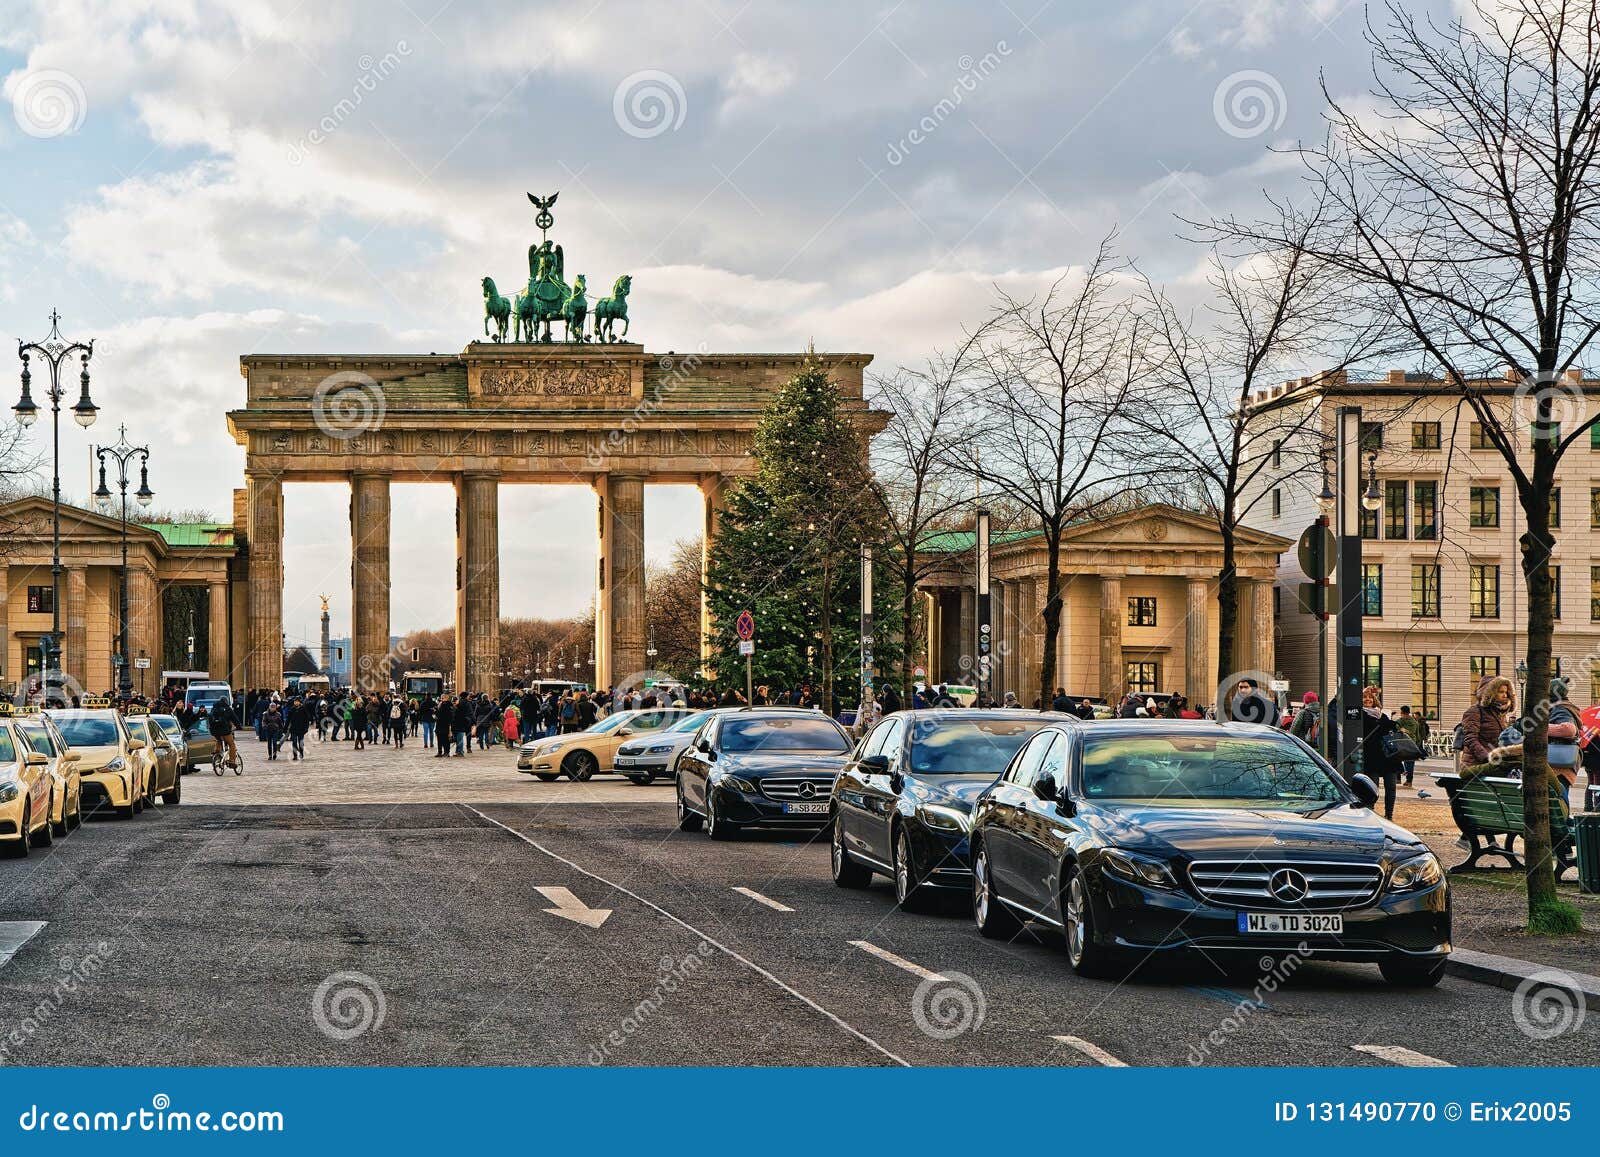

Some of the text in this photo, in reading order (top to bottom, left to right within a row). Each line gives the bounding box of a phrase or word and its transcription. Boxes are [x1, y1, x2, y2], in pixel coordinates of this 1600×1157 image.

[1249, 915, 1267, 931] WI
[1279, 915, 1299, 931] TD
[1303, 916, 1341, 931] 3020
